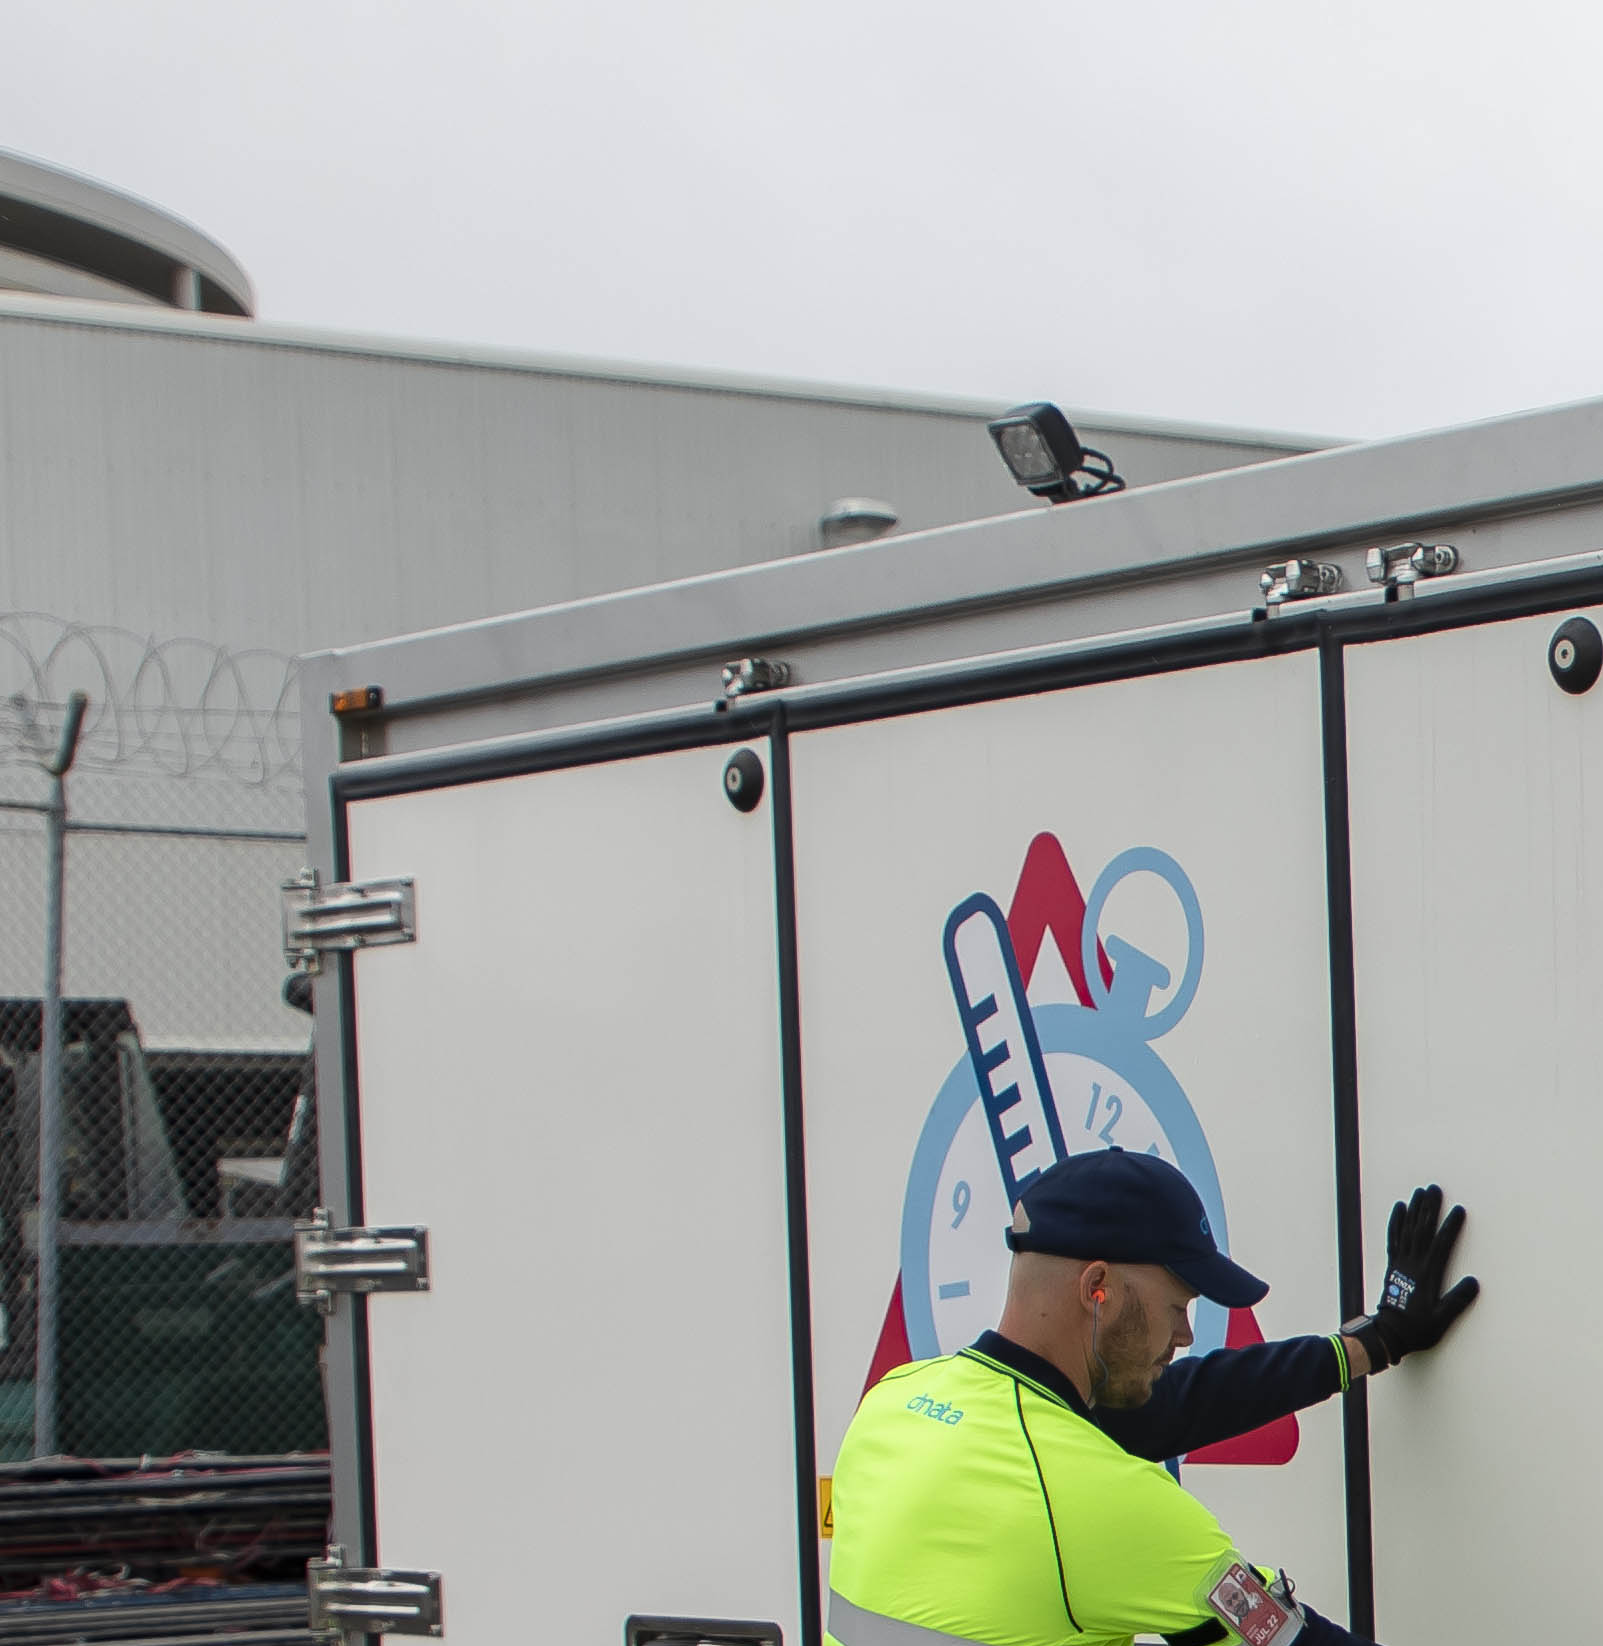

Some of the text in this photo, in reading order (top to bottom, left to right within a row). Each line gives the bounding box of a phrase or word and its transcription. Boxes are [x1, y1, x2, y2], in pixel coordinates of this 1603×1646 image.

[1084, 1081, 1123, 1146] 12
[951, 1180, 971, 1230] 9
[906, 1393, 965, 1425] dnata
[1253, 1628, 1270, 1646] JUL
